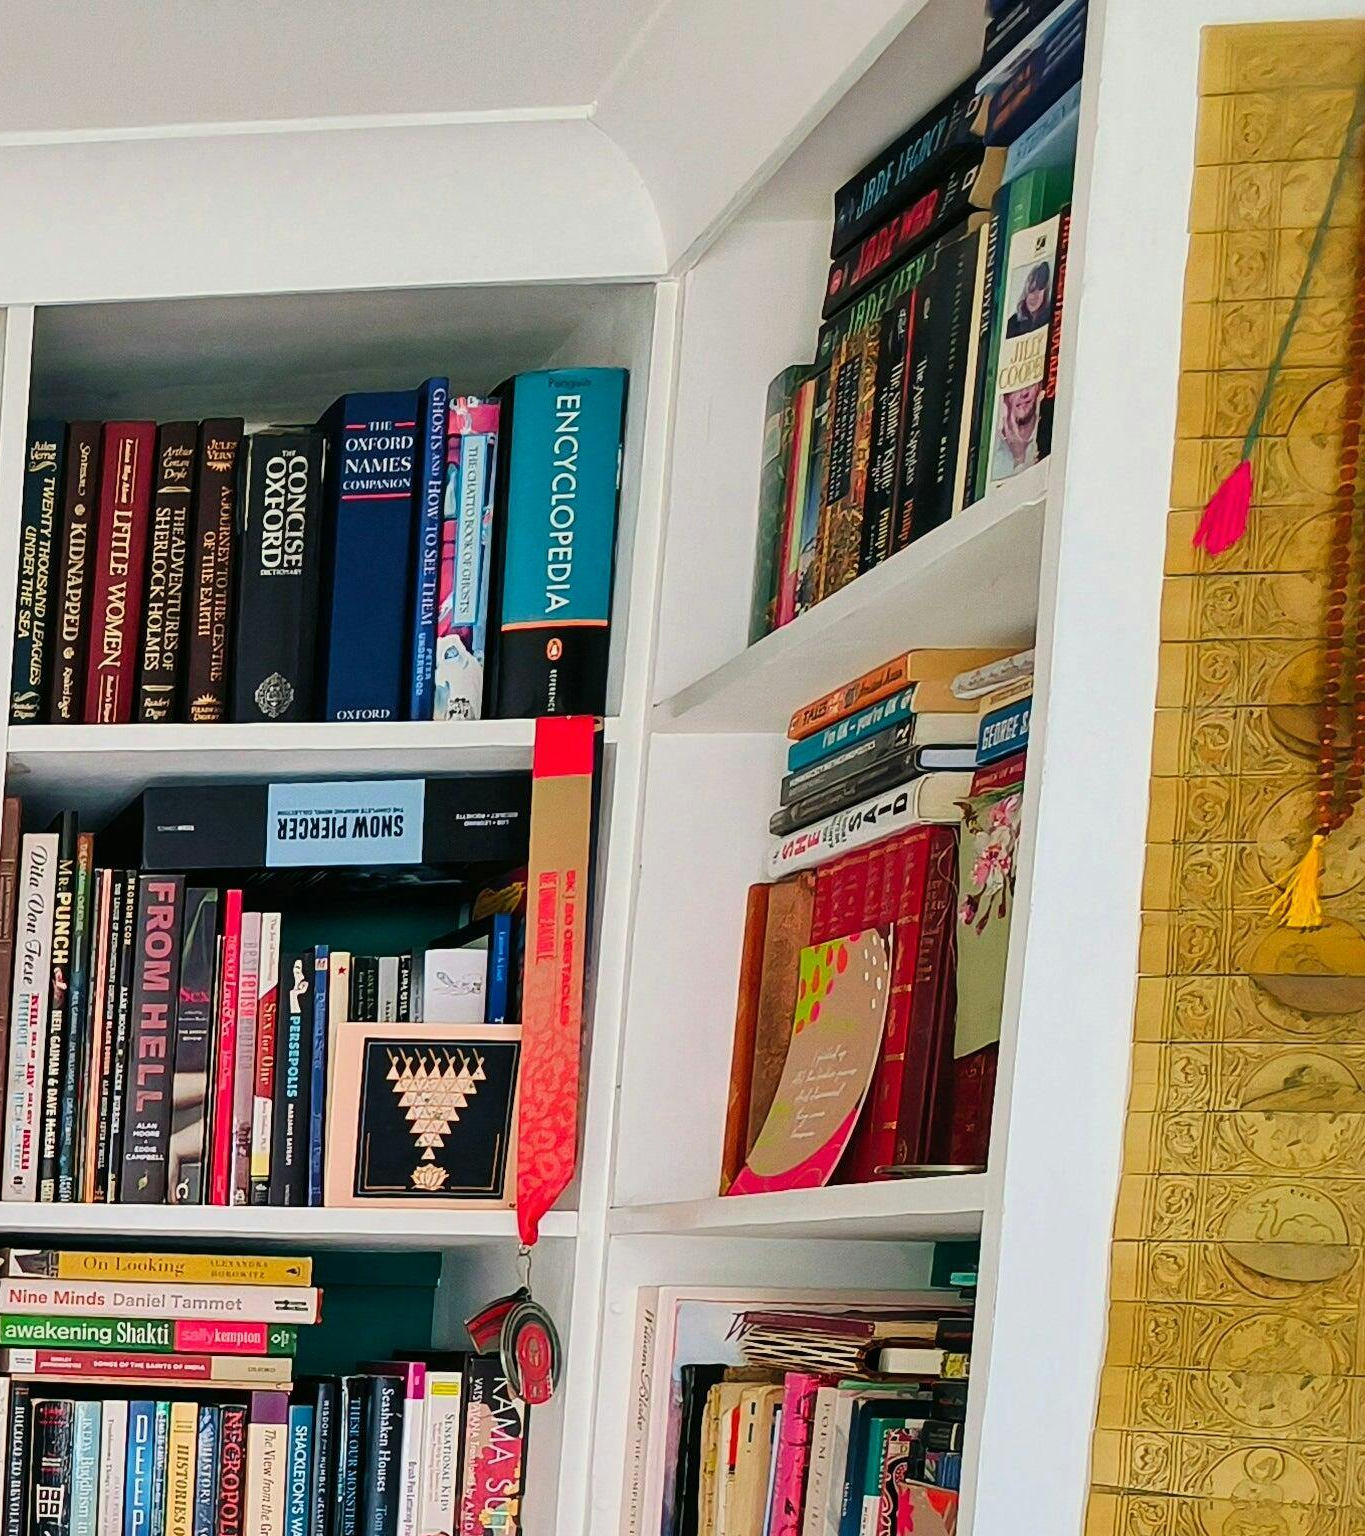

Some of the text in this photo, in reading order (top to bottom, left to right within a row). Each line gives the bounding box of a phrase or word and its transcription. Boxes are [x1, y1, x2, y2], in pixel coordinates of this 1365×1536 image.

[344, 457, 412, 474] NAMES
[345, 436, 413, 452] OXFORD
[342, 479, 412, 491] COMPANION
[420, 387, 446, 626] GHOSTS AND HOW TO SEE THEM
[544, 394, 582, 614] ENCYCLOPEDIA
[260, 456, 286, 569] OXFORD
[285, 454, 308, 568] CONCISE
[17, 526, 37, 639] UNDER THE SEA
[29, 477, 56, 685] TWENTY THOUSAND LEAGUES
[62, 522, 87, 641] KIDNAPPED
[97, 510, 133, 670] LITTLE WOMEN
[143, 507, 170, 671] SHERLOCK HOLMES
[161, 507, 187, 671] THE ADVENTURES OF
[276, 814, 405, 841] SNOW PIERCER
[848, 792, 909, 833] SAID
[27, 845, 49, 890] Dita
[781, 829, 822, 860] SHE
[26, 894, 45, 934] Von
[53, 859, 73, 964] MR. PUNCH
[22, 939, 43, 986] Teese
[135, 882, 176, 1113] FROM HELL
[50, 1009, 63, 1034] NEIL
[48, 1035, 62, 1077] GAIMAN
[286, 1015, 301, 1098] PERSEPOLIS
[46, 1087, 59, 1117] DAVE
[83, 1256, 187, 1280] On Looking
[8, 1290, 243, 1312] Nine Minds Daniel Tammet
[4, 1321, 261, 1347] awakening Shakti sally kempton
[378, 1387, 394, 1447] Seashaken
[173, 1443, 190, 1524] HISTORIES
[290, 1425, 308, 1515] SHACKLETON'S
[376, 1449, 390, 1492] Houses
[374, 1504, 388, 1531] Tom
